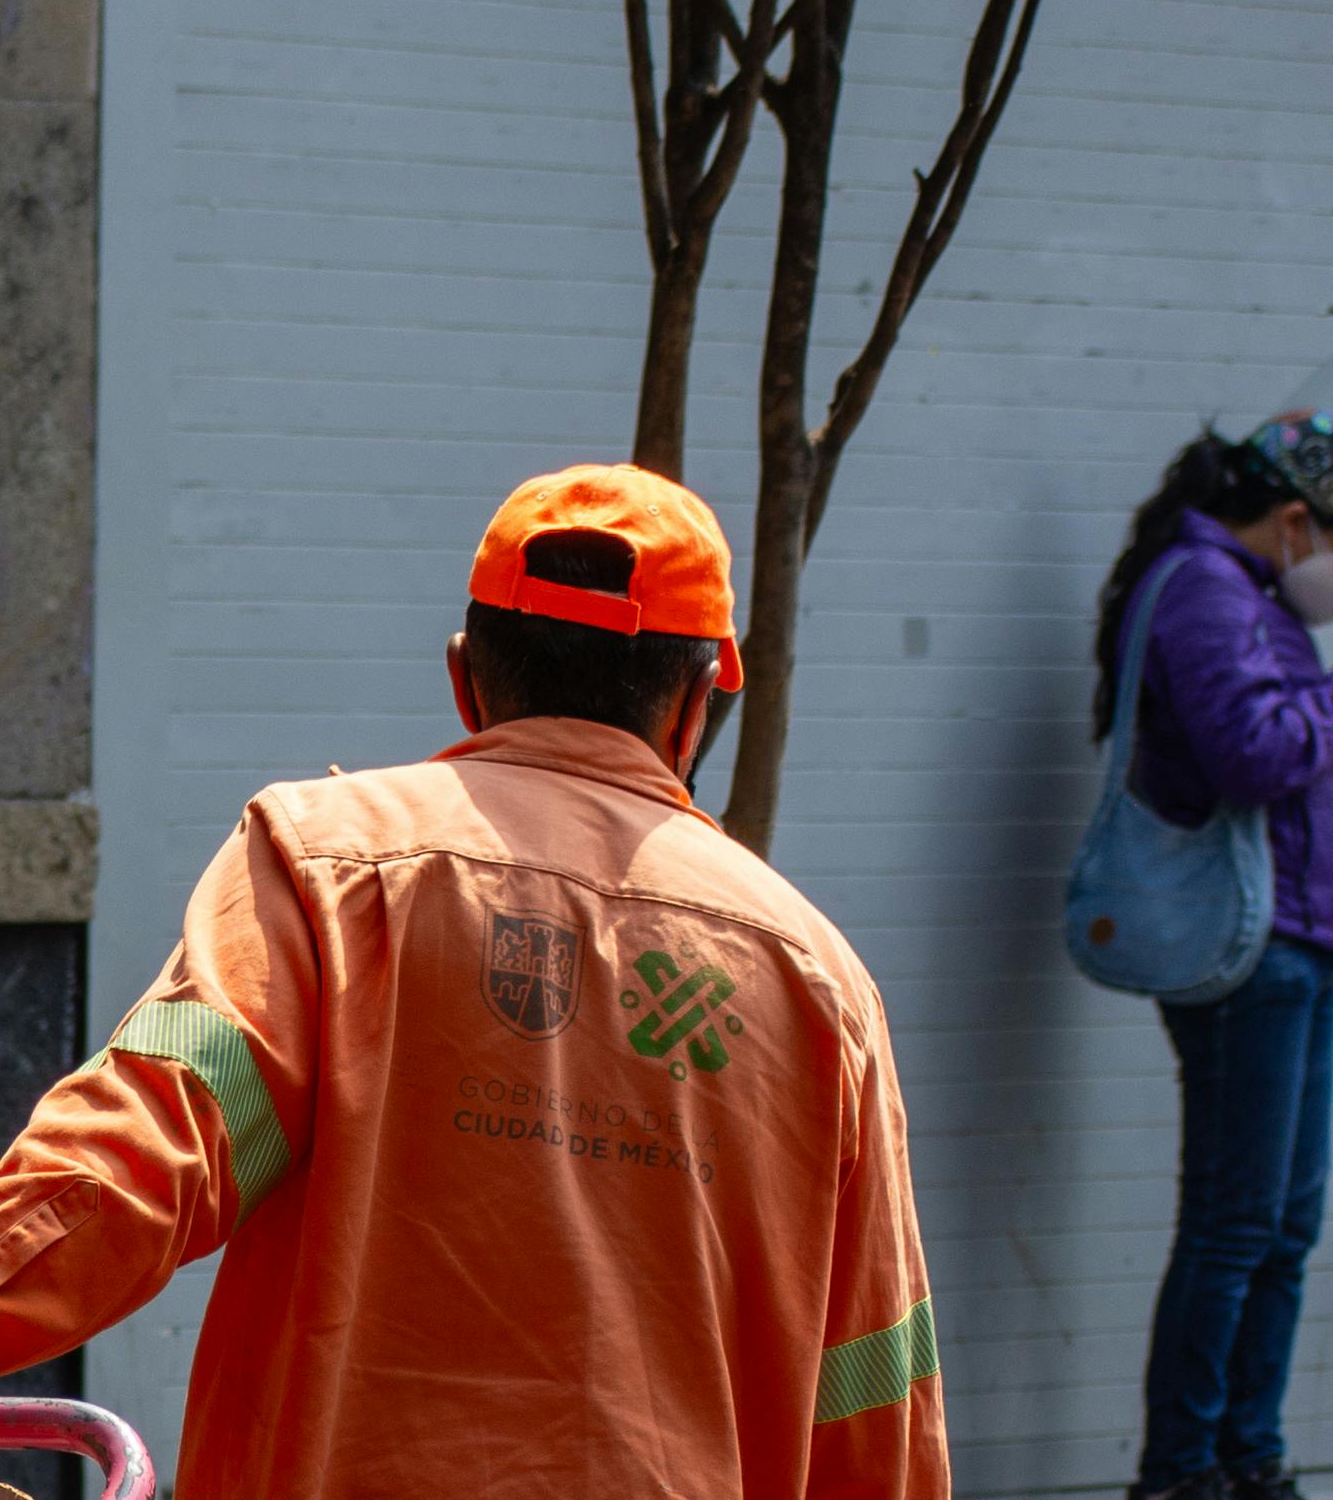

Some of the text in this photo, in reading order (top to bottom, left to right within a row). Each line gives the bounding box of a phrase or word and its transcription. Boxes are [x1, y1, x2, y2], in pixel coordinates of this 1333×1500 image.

[458, 1076, 627, 1127] GOBIERNO
[643, 1110, 683, 1136] DE
[453, 1110, 714, 1183] CIUDAD DE MÉXIO
